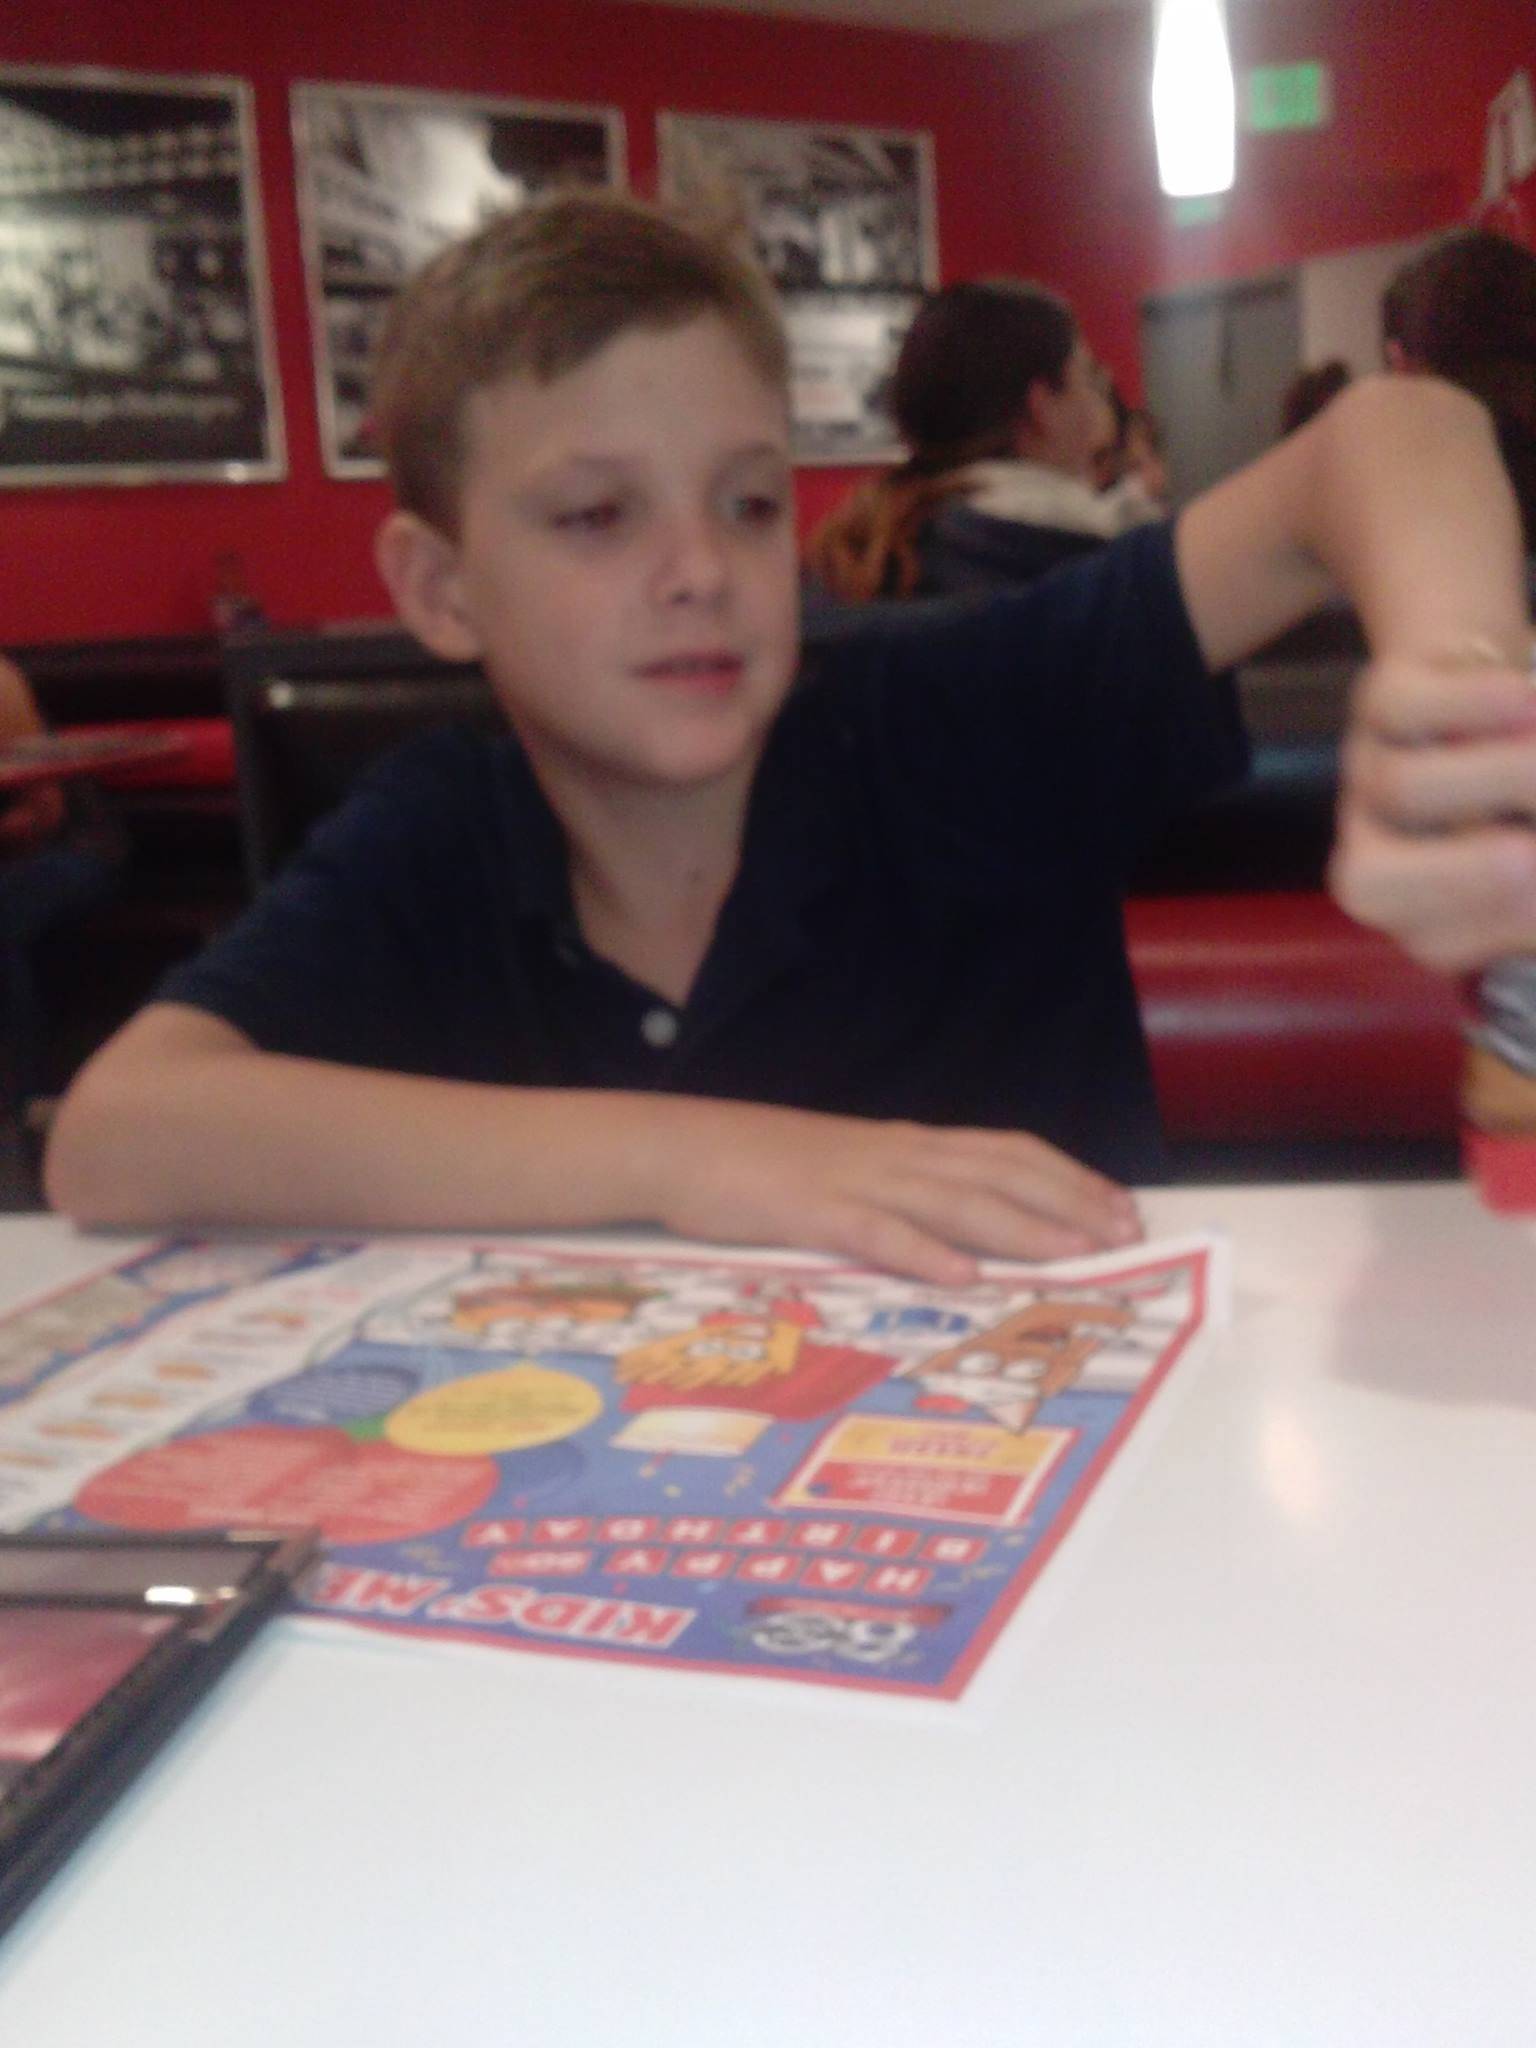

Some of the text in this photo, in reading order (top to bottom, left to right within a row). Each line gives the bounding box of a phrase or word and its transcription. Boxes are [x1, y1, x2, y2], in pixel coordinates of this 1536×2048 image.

[470, 1516, 978, 1562] BIRTHDAY
[612, 1548, 925, 1593] HAPPY
[427, 1584, 696, 1649] KIDS'
